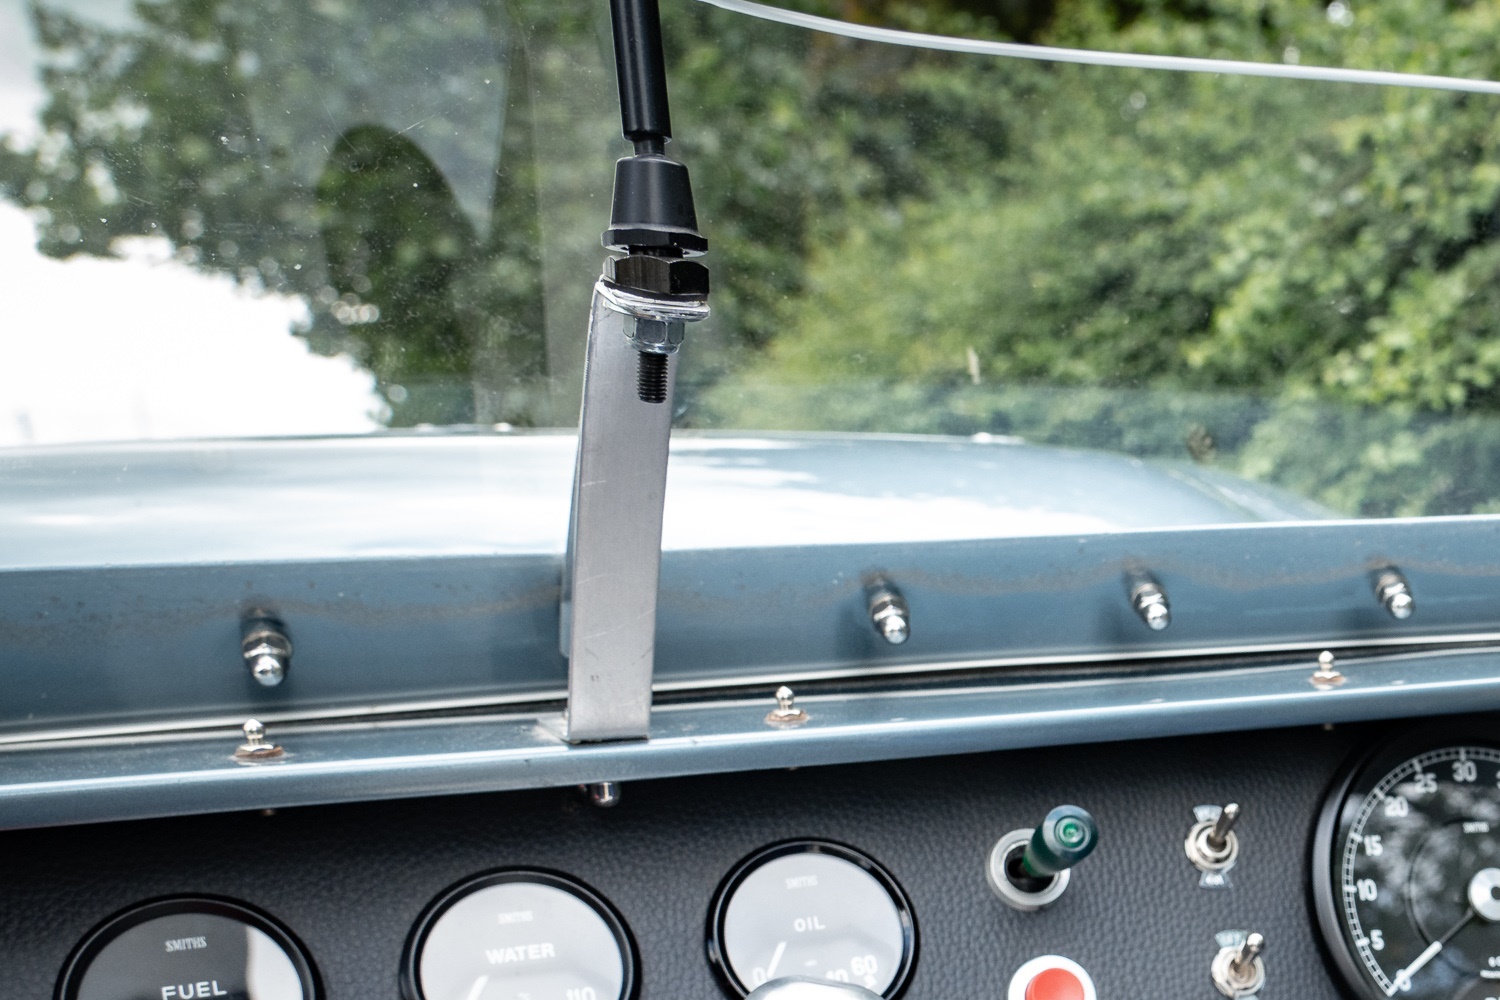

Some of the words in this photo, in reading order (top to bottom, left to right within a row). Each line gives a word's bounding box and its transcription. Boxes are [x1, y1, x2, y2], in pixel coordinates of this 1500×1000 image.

[1452, 761, 1477, 782] 30
[1414, 772, 1438, 793] 25
[1384, 796, 1409, 817] 20
[1364, 834, 1383, 856] 15
[1357, 878, 1378, 901] 10
[794, 917, 826, 932] OIL
[164, 936, 207, 952] SMITHS
[1370, 929, 1385, 950] 5
[485, 943, 556, 964] WATER
[851, 955, 878, 976] 60
